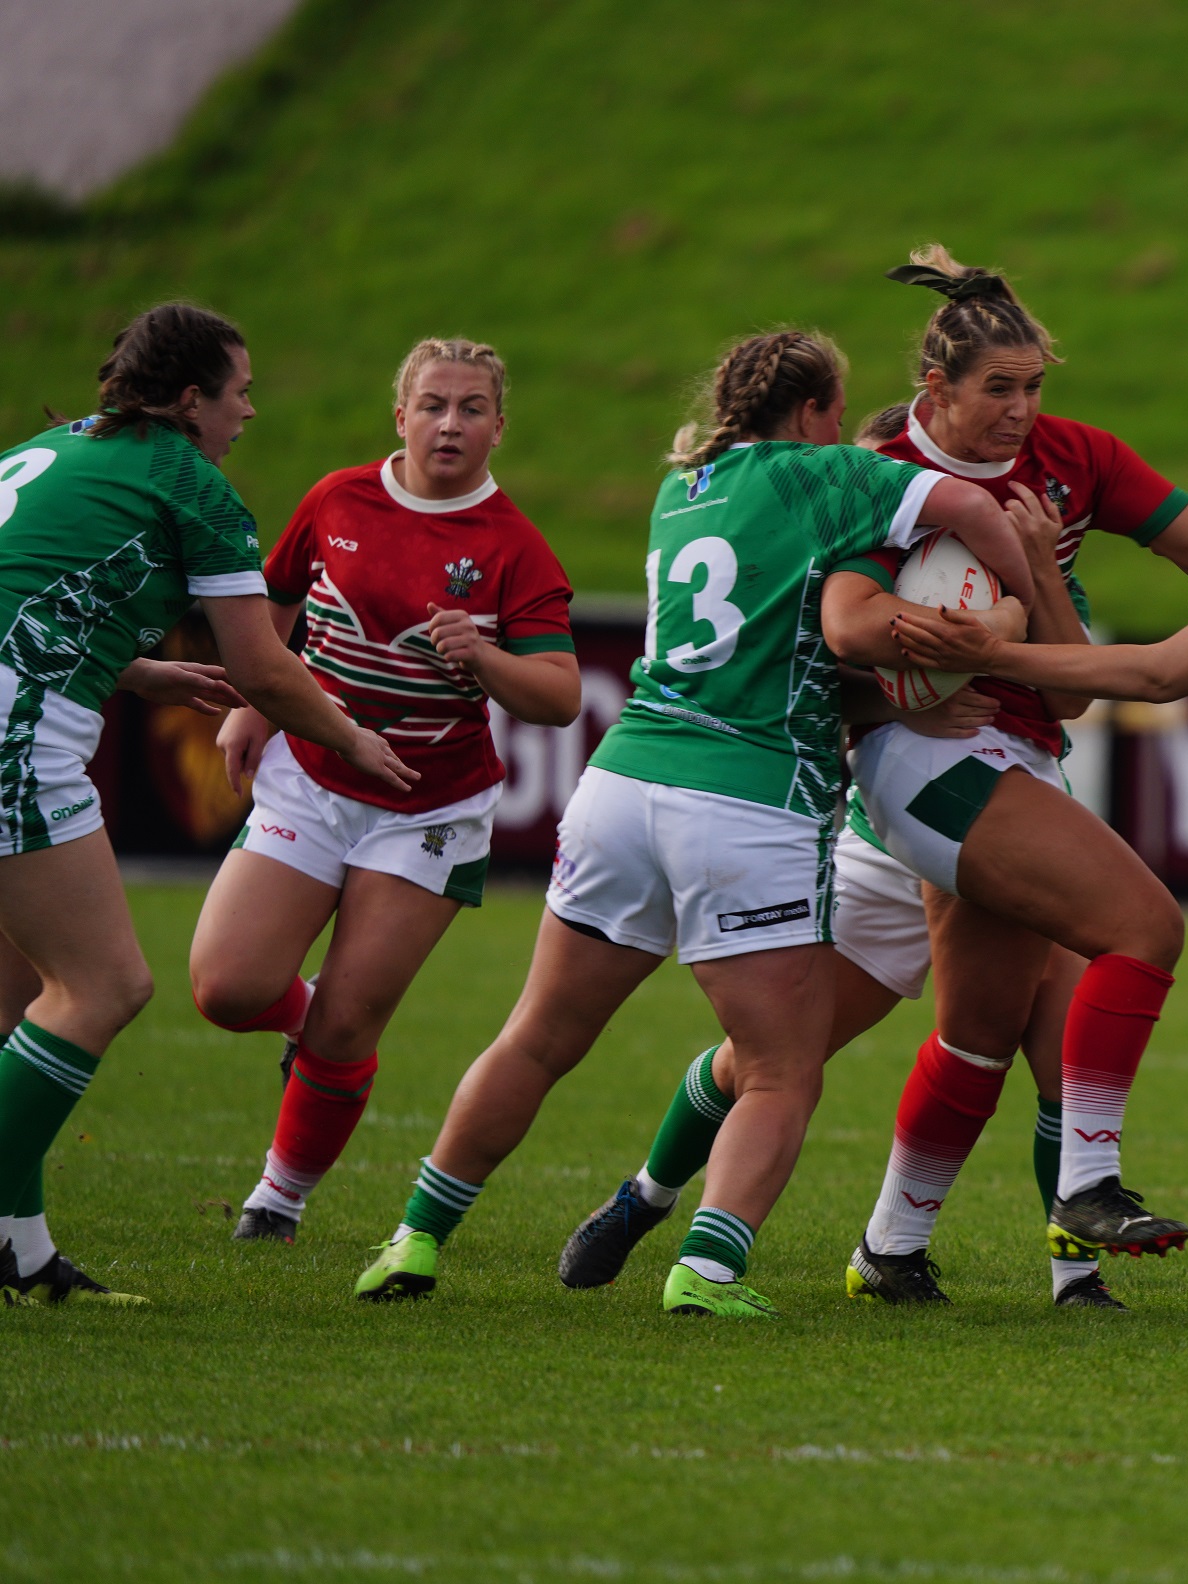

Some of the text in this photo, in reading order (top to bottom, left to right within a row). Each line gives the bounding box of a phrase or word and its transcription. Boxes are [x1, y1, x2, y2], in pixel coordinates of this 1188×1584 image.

[327, 534, 358, 552] VX3
[261, 824, 296, 842] VX3
[743, 909, 783, 924] FORTAY
